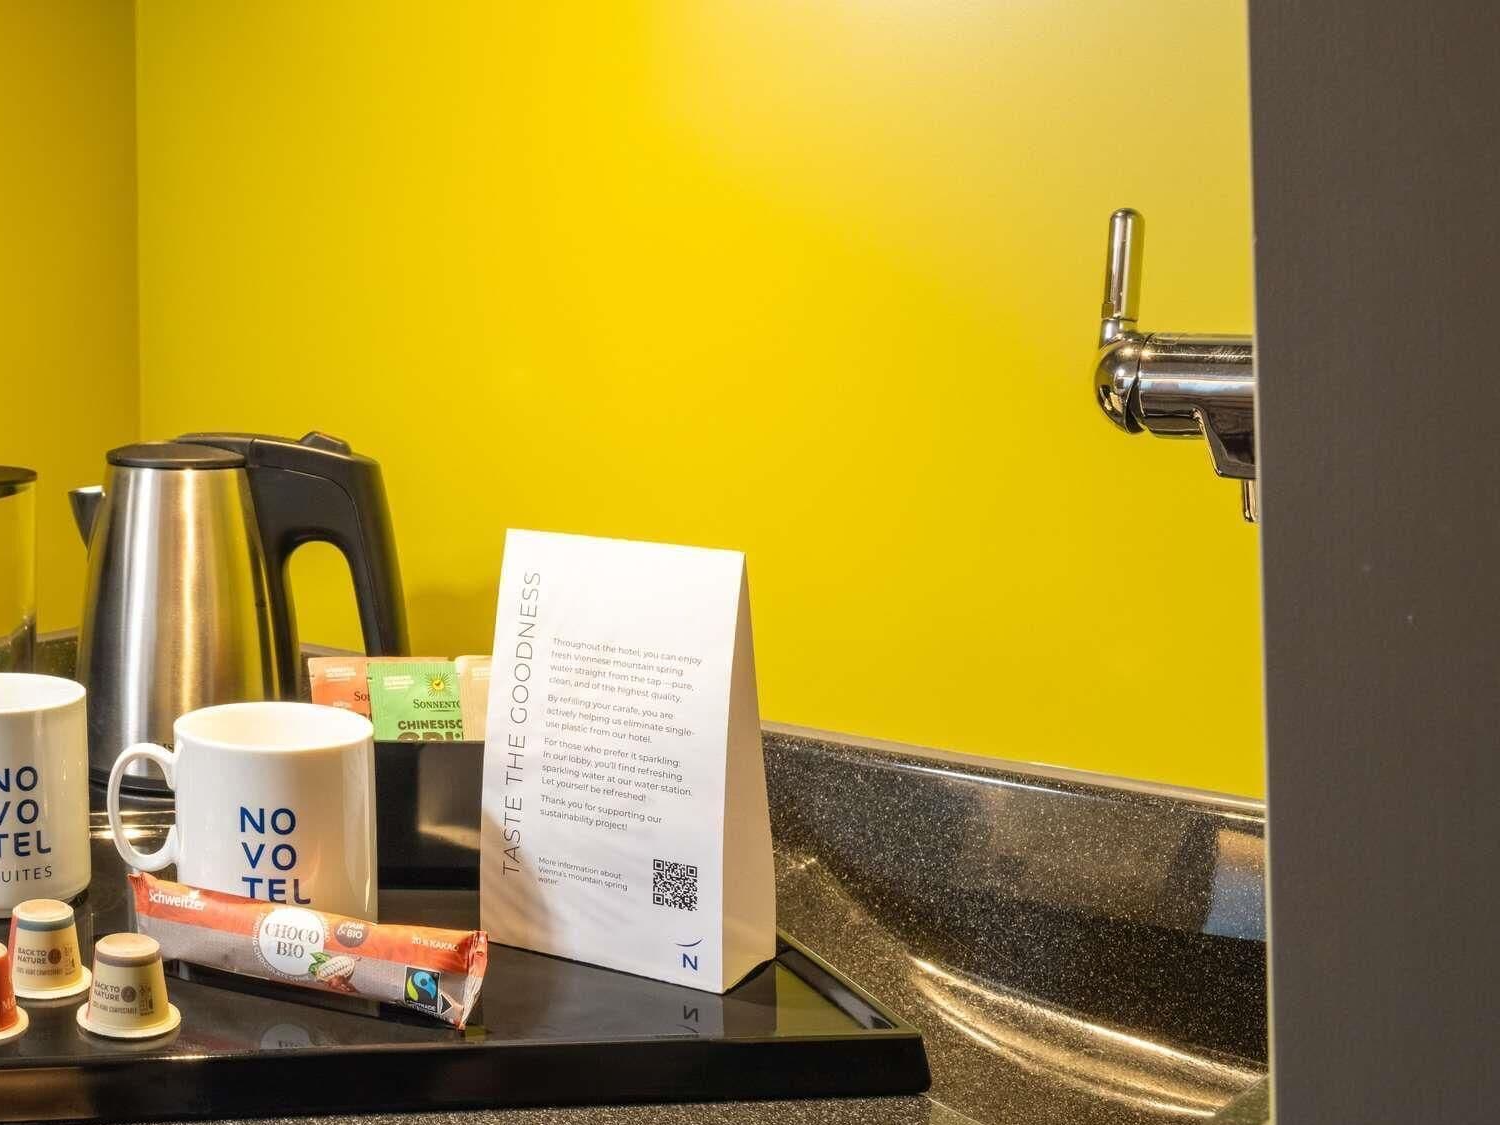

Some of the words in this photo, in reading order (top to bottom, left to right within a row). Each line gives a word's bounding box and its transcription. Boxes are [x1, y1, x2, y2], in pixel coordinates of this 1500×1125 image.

[510, 571, 541, 724] GOODNESS
[553, 638, 600, 651] Throughout
[602, 644, 616, 653] the
[619, 646, 641, 657] hotel,
[644, 652, 658, 660] you
[661, 653, 677, 661] can
[678, 655, 702, 666] enjoy
[552, 651, 571, 660] fresh
[574, 653, 611, 665] Viennese
[613, 660, 654, 671] mountain
[656, 666, 683, 676] spring
[550, 665, 573, 673] water
[575, 667, 606, 679] straight
[609, 671, 628, 681] from
[631, 675, 645, 683] the
[647, 677, 662, 686] tap
[549, 677, 572, 686] clean,
[574, 680, 590, 688] and
[591, 681, 600, 689] of
[602, 684, 616, 692] the
[618, 686, 649, 698] highest
[651, 691, 682, 703] quality.
[548, 694, 558, 703] By
[560, 696, 591, 709] refilling
[592, 702, 610, 711] your
[613, 703, 640, 715] carafe,
[642, 709, 658, 717] you
[546, 708, 577, 719] actively
[579, 712, 610, 725] helping
[623, 719, 663, 732] eliminate
[665, 726, 695, 737] single-
[546, 721, 560, 729] use
[562, 723, 588, 734] plastic
[589, 727, 610, 737] from
[612, 731, 626, 739] our
[628, 733, 652, 743] hotel.
[505, 734, 525, 785] THE
[544, 738, 557, 746] For
[559, 740, 582, 751] those
[583, 745, 602, 753] who
[603, 748, 629, 758] prefer
[542, 764, 580, 778] sparkling
[582, 771, 605, 781] water
[607, 775, 616, 783] at
[618, 778, 632, 786] our
[543, 751, 550, 759] In
[553, 753, 567, 761] our
[568, 755, 592, 766] lobby,
[618, 764, 636, 773] find
[638, 767, 683, 782] refreshing
[542, 777, 556, 785] Let
[556, 780, 588, 791] yourself
[591, 785, 601, 793] be
[603, 788, 646, 802] refreshed!
[540, 808, 594, 825] sustainability
[595, 818, 628, 831] project!
[541, 795, 566, 805] Thank
[567, 801, 583, 809] you
[585, 802, 596, 811] for
[598, 806, 645, 822] supporting
[647, 815, 662, 823] our
[239, 806, 296, 836] NO
[503, 795, 522, 875] TASTE
[242, 842, 297, 871] VO
[539, 857, 557, 866] More
[557, 860, 598, 875] information
[600, 869, 621, 879] about
[242, 876, 312, 905] TEL
[538, 866, 567, 878] Vienna's
[568, 873, 603, 885] mountain
[604, 880, 628, 892] spring
[149, 889, 206, 911] Schweitzer
[265, 922, 320, 944] CHOCO
[346, 929, 363, 939] BIO
[17, 955, 47, 965] NATURE
[18, 947, 35, 956] BACK
[36, 949, 47, 957] TO
[276, 941, 304, 959] BIO
[94, 990, 120, 1001] NATURE
[95, 980, 110, 992] BACK
[110, 985, 120, 993] TO
